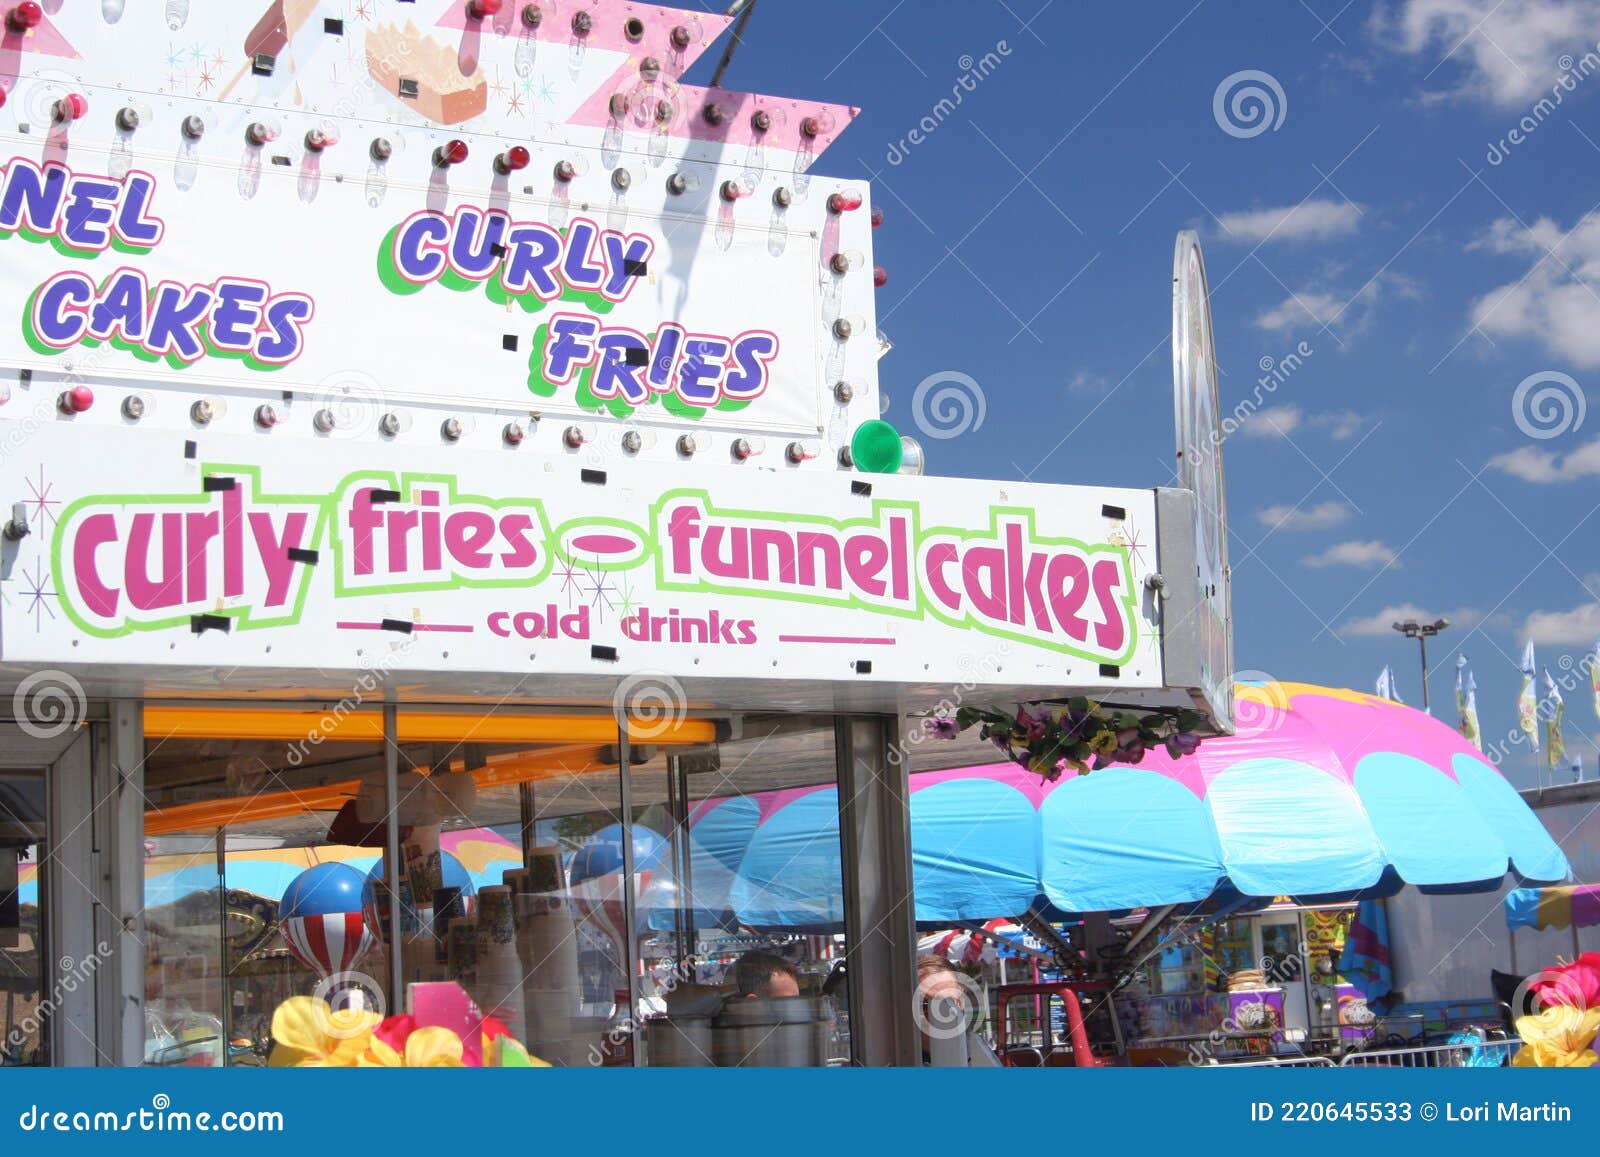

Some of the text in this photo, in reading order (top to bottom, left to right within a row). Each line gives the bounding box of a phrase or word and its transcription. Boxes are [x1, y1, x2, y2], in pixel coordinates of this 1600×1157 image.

[392, 204, 654, 303] CURLY
[30, 267, 315, 364] CAKES
[540, 312, 779, 407] FRIES
[73, 481, 309, 618] curly
[348, 486, 538, 576] fries
[667, 505, 910, 601] funnel
[925, 523, 1126, 651] cakes
[486, 603, 758, 645] cold drinks
